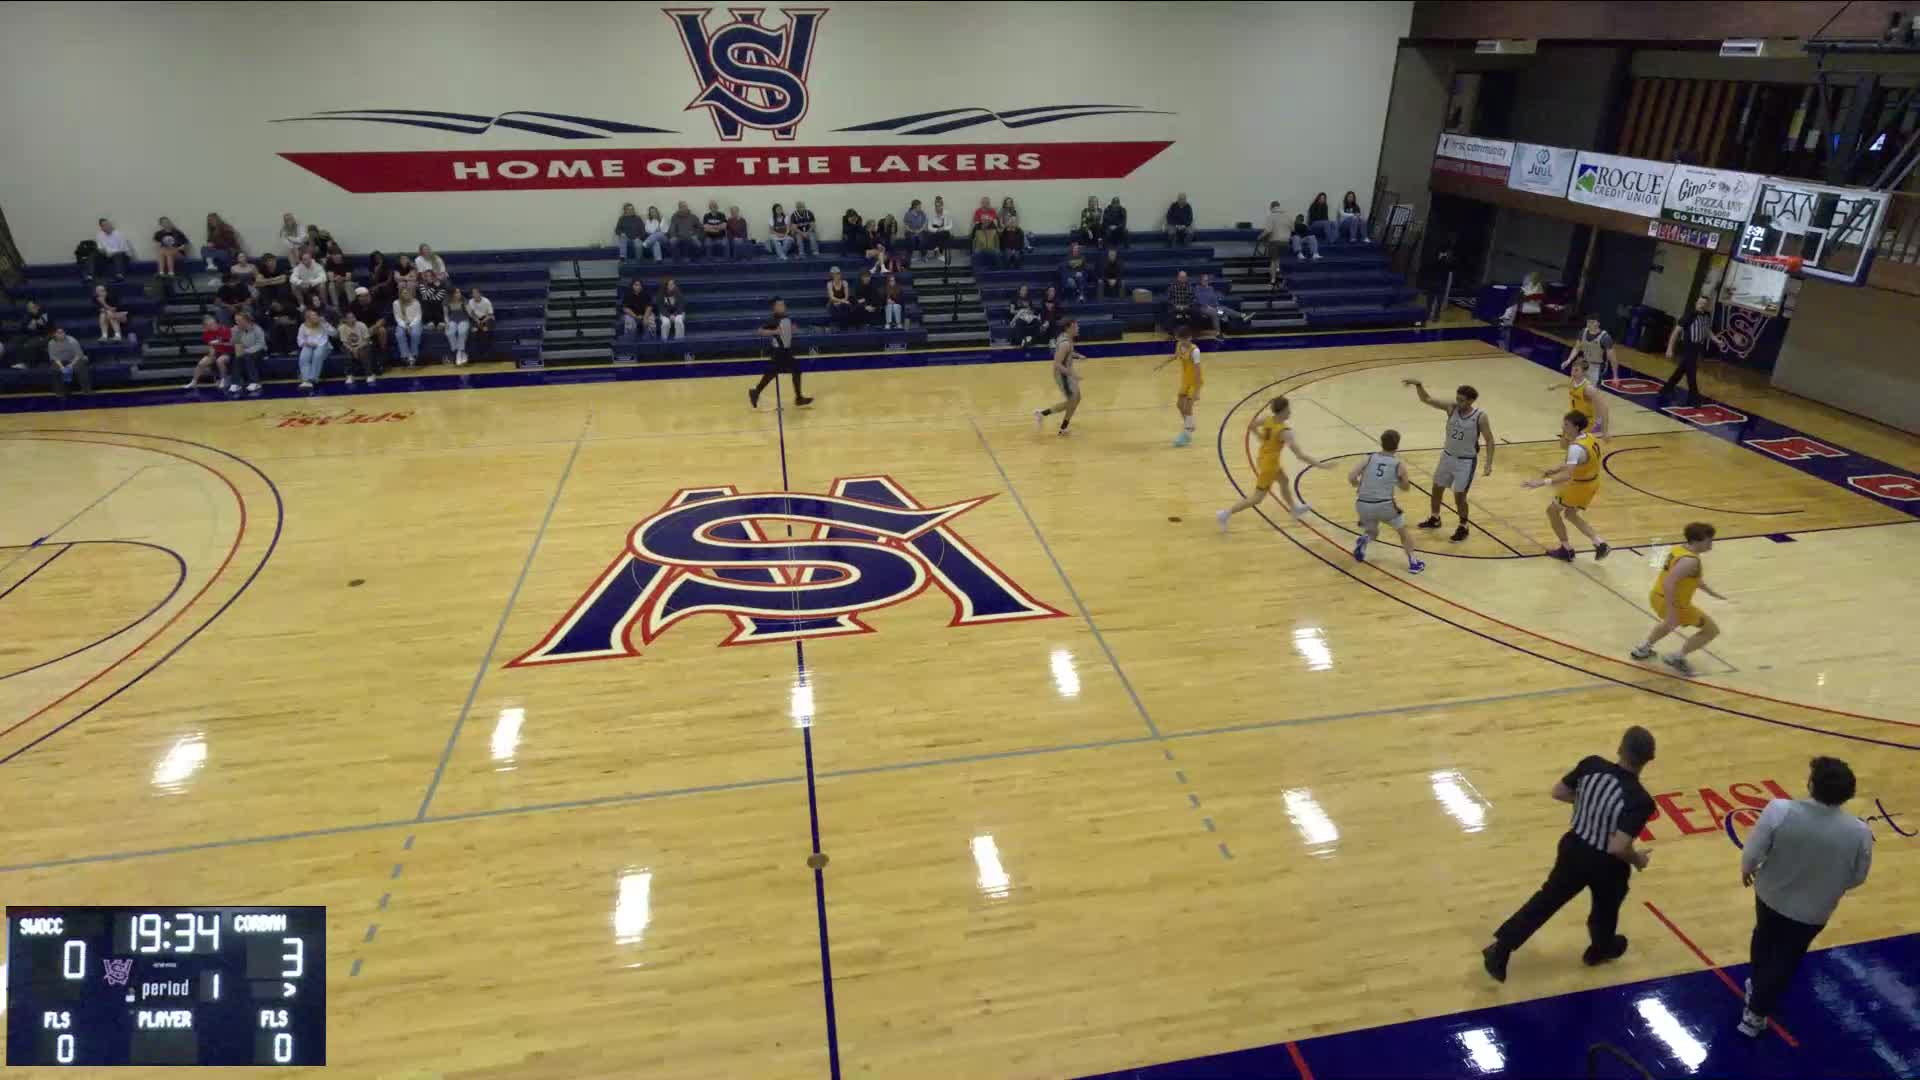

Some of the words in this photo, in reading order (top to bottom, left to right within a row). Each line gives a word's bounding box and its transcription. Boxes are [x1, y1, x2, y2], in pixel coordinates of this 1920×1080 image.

[453, 159, 625, 180] HOME
[646, 157, 716, 177] OF
[736, 156, 830, 175] THE
[850, 152, 1041, 173] LAKERS
[1598, 166, 1664, 195] ROGUE
[1678, 178, 1716, 202] Gino's
[1594, 185, 1627, 199] CREDIT
[1626, 191, 1661, 205] UNION
[1695, 196, 1724, 209] PIZZA
[1673, 211, 1688, 221] Go
[1690, 214, 1739, 231] LAKERS!
[1451, 428, 1465, 441] 23
[1375, 463, 1387, 477] 5
